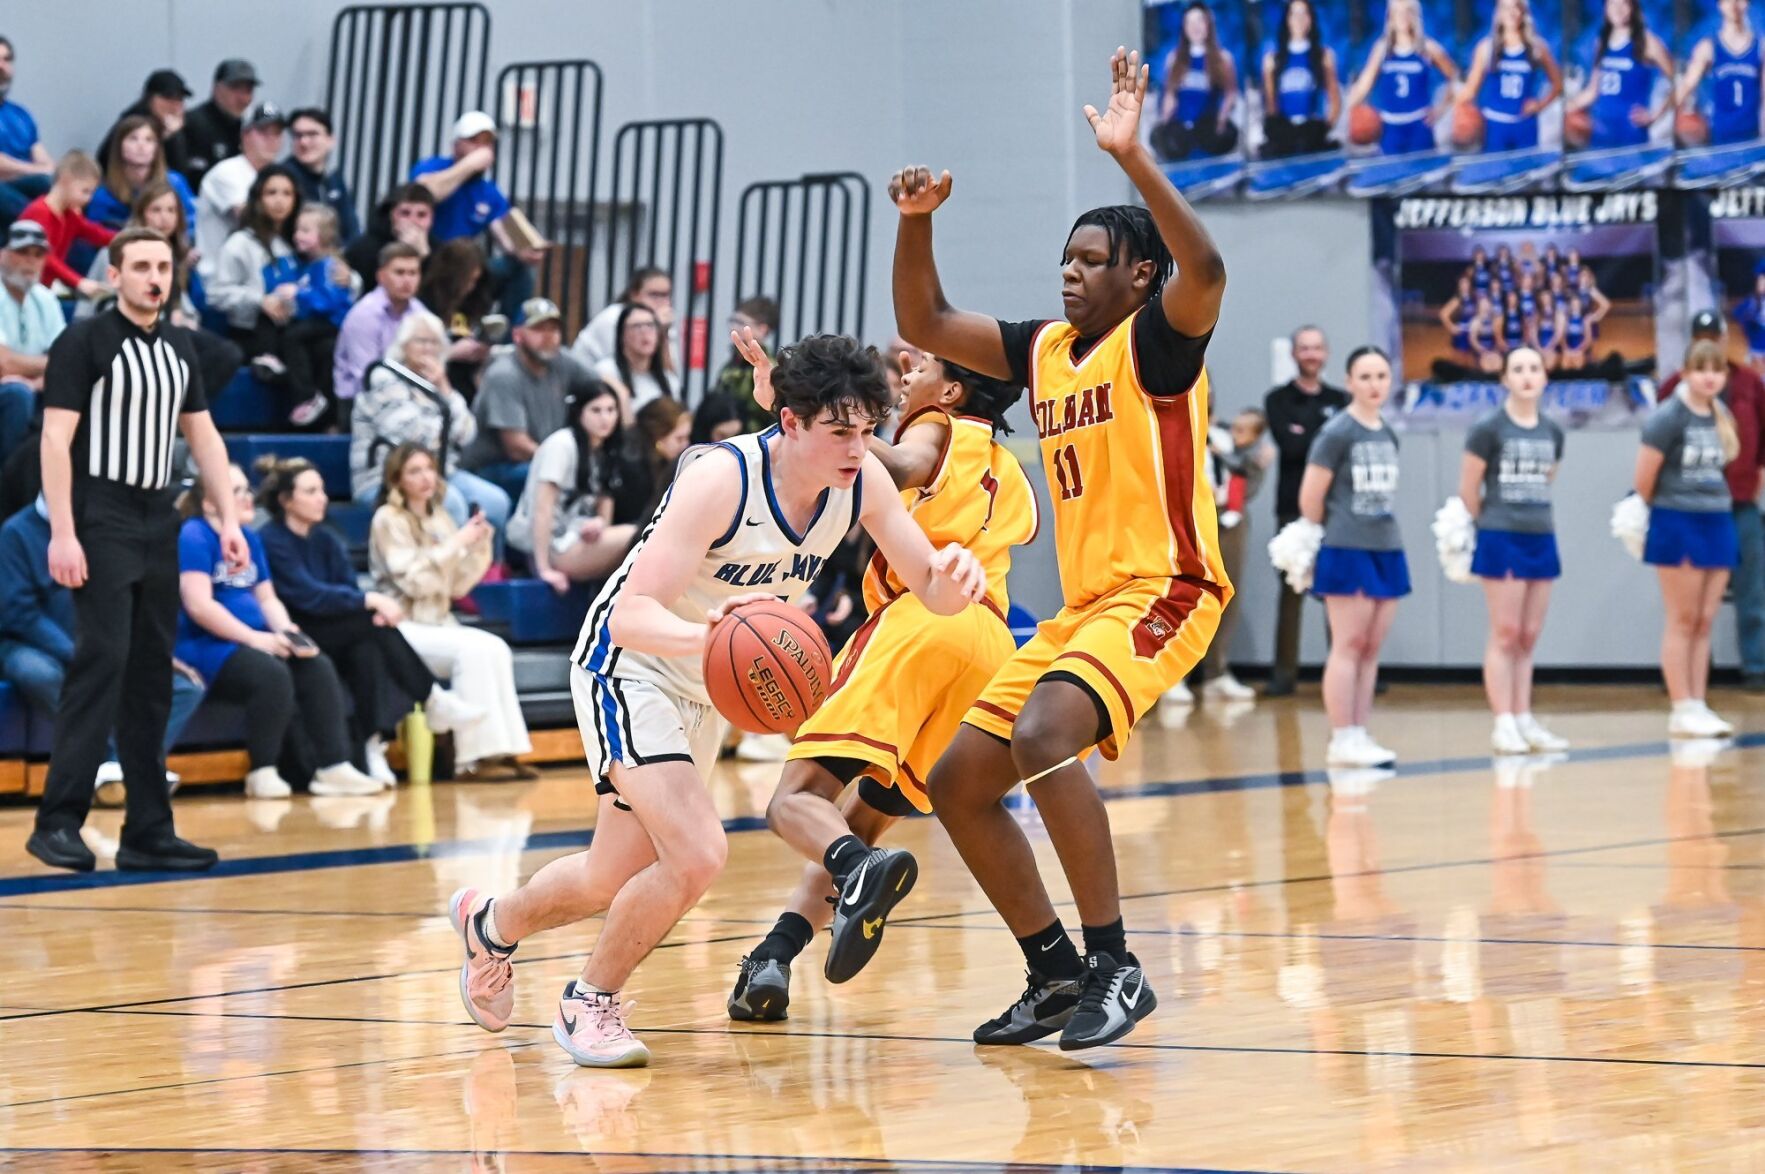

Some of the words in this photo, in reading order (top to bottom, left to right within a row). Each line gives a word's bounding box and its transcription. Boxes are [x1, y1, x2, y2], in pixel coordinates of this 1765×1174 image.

[1394, 197, 1527, 228] JEFFERSON
[1531, 195, 1592, 226] BLUE
[1595, 190, 1658, 222] JAYS
[1053, 444, 1084, 501] 11
[713, 558, 782, 586] BLUE
[752, 655, 796, 719] LEGACY
